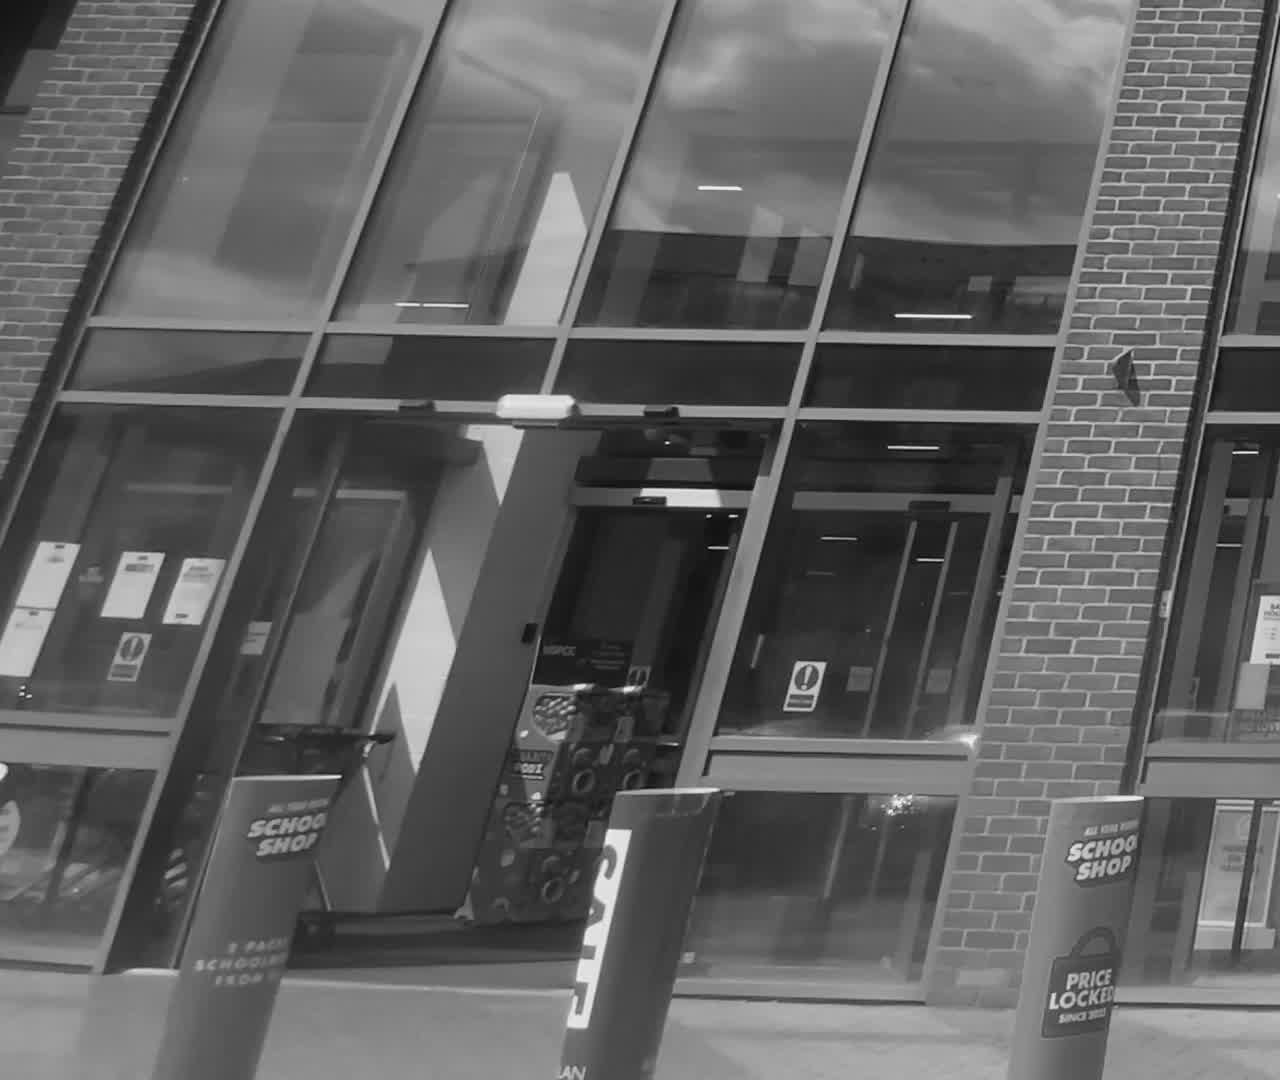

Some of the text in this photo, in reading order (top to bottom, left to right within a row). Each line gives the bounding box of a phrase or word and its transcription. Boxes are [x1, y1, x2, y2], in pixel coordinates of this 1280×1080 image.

[247, 812, 329, 838] SCHOO
[1066, 834, 1139, 862] SCHOO
[1075, 855, 1133, 881] SHOP
[1065, 968, 1113, 991] PRICE
